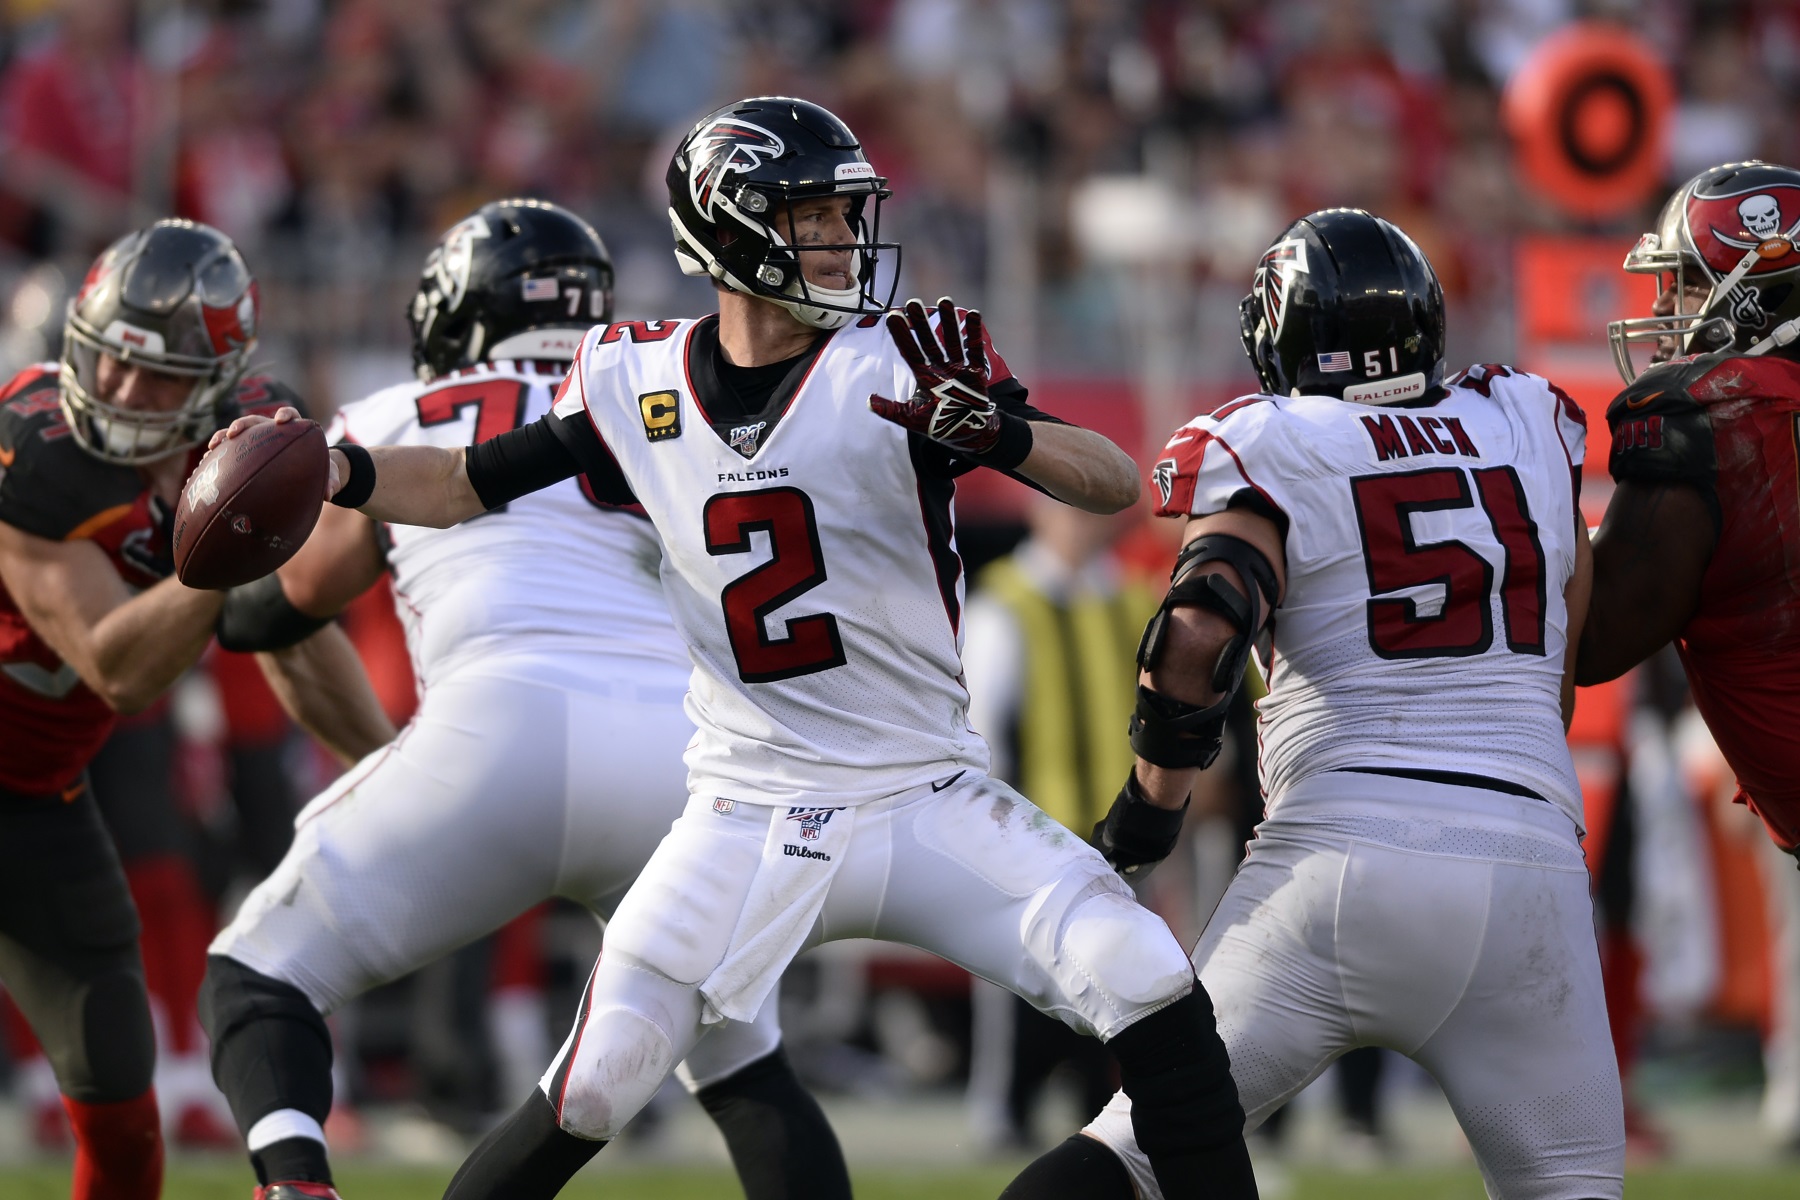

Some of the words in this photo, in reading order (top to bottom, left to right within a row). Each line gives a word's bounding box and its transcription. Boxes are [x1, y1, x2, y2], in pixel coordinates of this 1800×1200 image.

[1363, 346, 1398, 377] 51
[1353, 382, 1420, 401] FALCONS
[641, 393, 676, 429] C
[1360, 413, 1480, 462] MACK
[718, 467, 789, 483] FALCONS
[1349, 464, 1547, 660] 51
[703, 486, 847, 683] 2
[715, 800, 732, 812] NFL
[802, 828, 817, 839] NFL
[783, 844, 828, 861] Wilson
